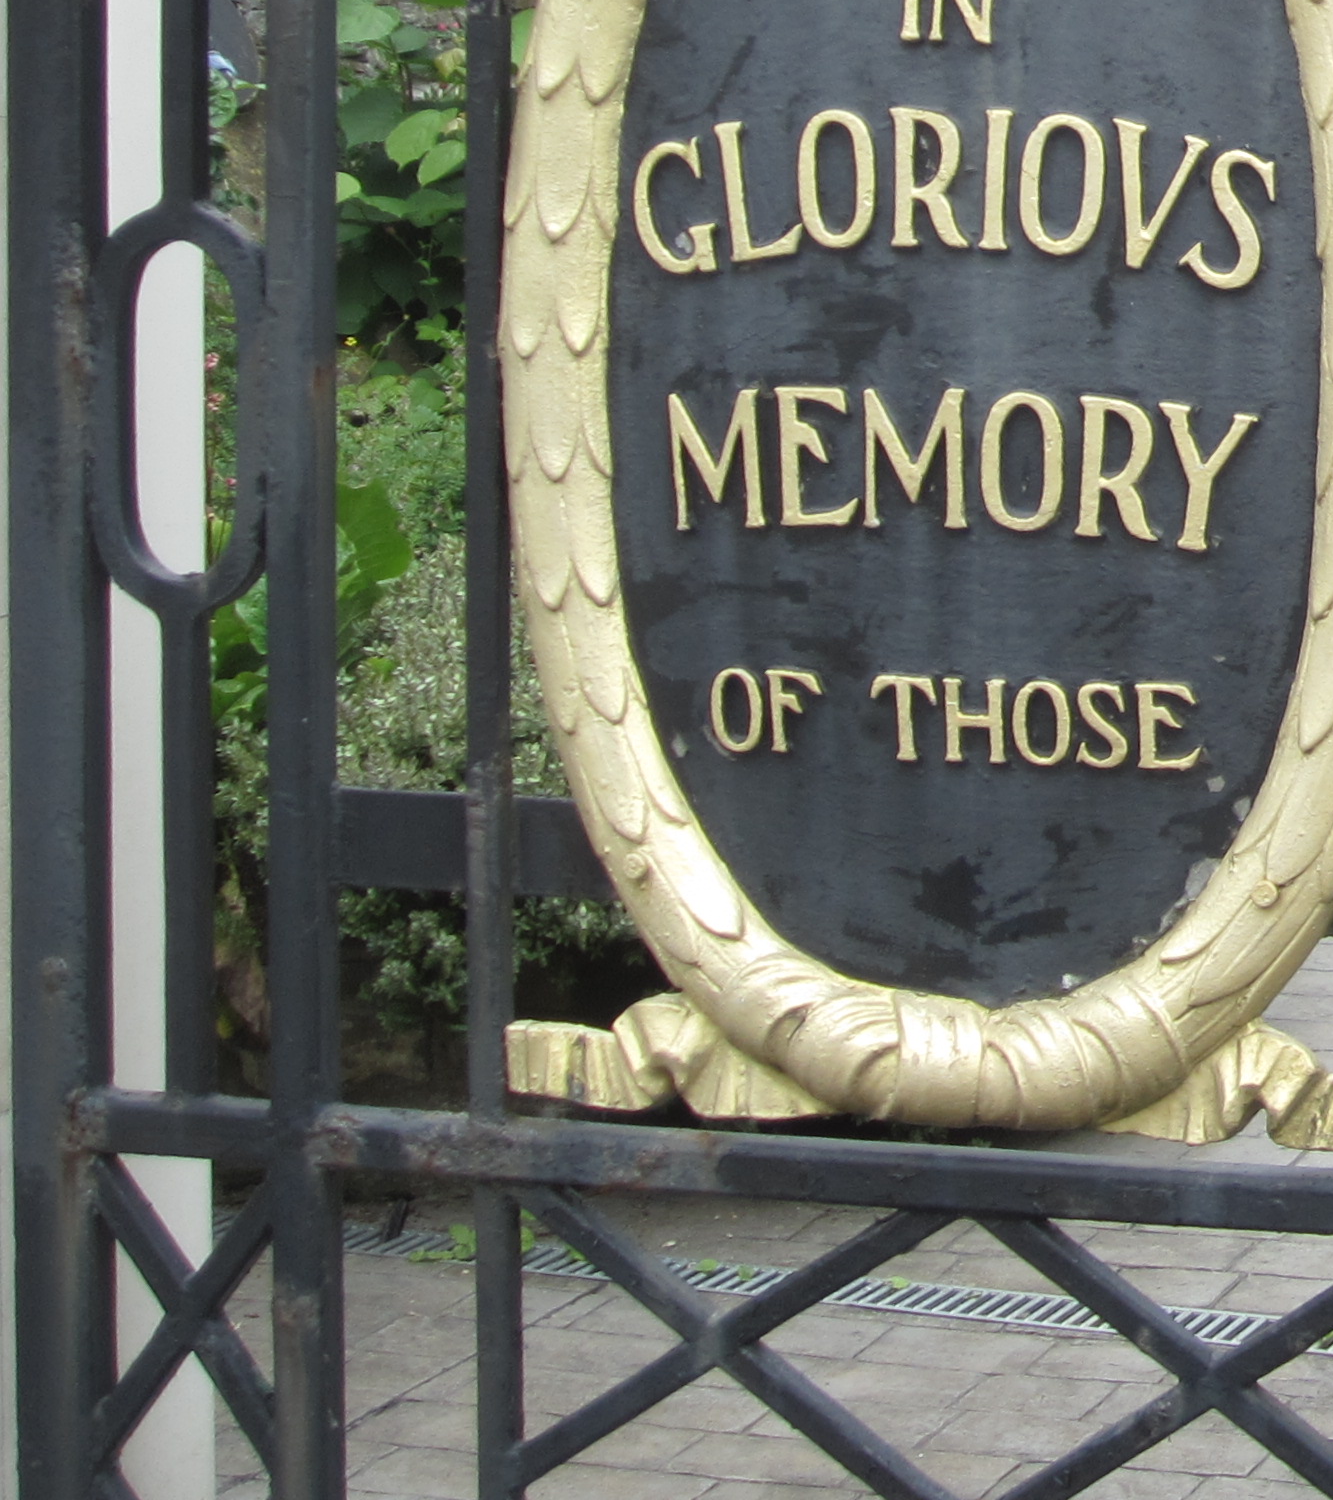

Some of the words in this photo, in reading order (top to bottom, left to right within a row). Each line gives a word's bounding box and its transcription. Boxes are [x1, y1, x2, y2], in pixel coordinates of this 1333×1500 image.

[632, 106, 1276, 290] GLORIOVS
[667, 386, 1258, 551] MEMORY
[710, 667, 824, 754] OF
[870, 674, 1202, 770] THOSE
